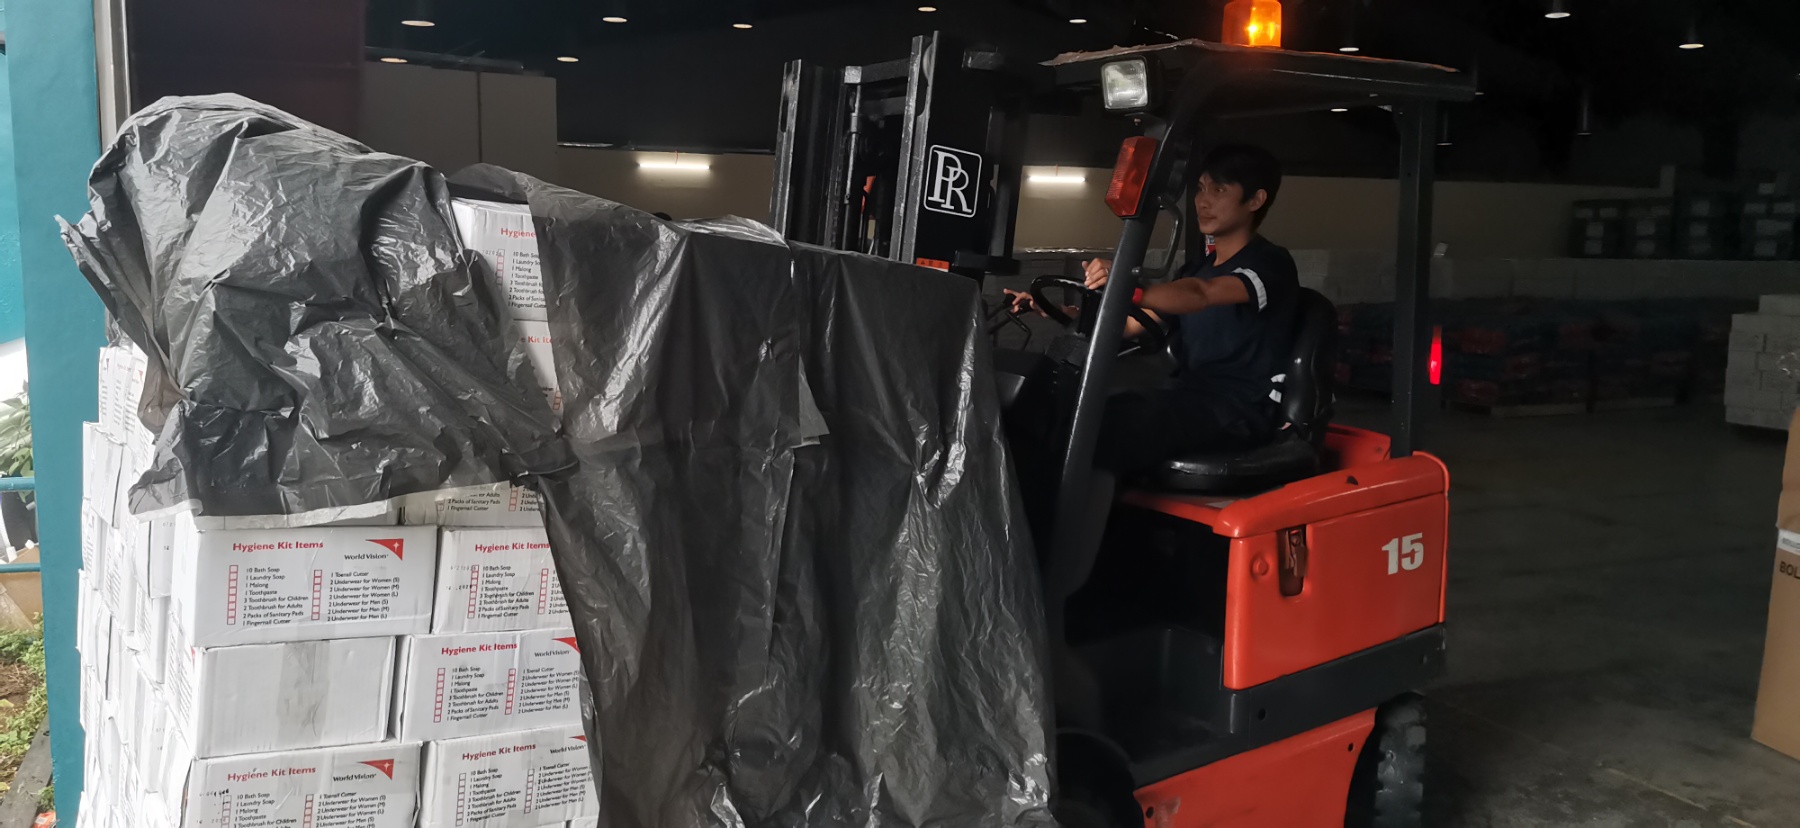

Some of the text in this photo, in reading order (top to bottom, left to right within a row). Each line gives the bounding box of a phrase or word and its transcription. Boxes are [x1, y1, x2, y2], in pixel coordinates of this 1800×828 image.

[500, 228, 537, 238] Hygiene
[233, 541, 324, 552] Hygiene Kit Items
[475, 544, 509, 553] Hygiene
[1381, 532, 1424, 575] 15
[441, 646, 477, 656] Hygiene
[494, 642, 518, 650] Items
[462, 743, 536, 761] Hygiene Kit Items
[227, 766, 317, 783] Hygiene Kit Items
[333, 774, 354, 782] World
